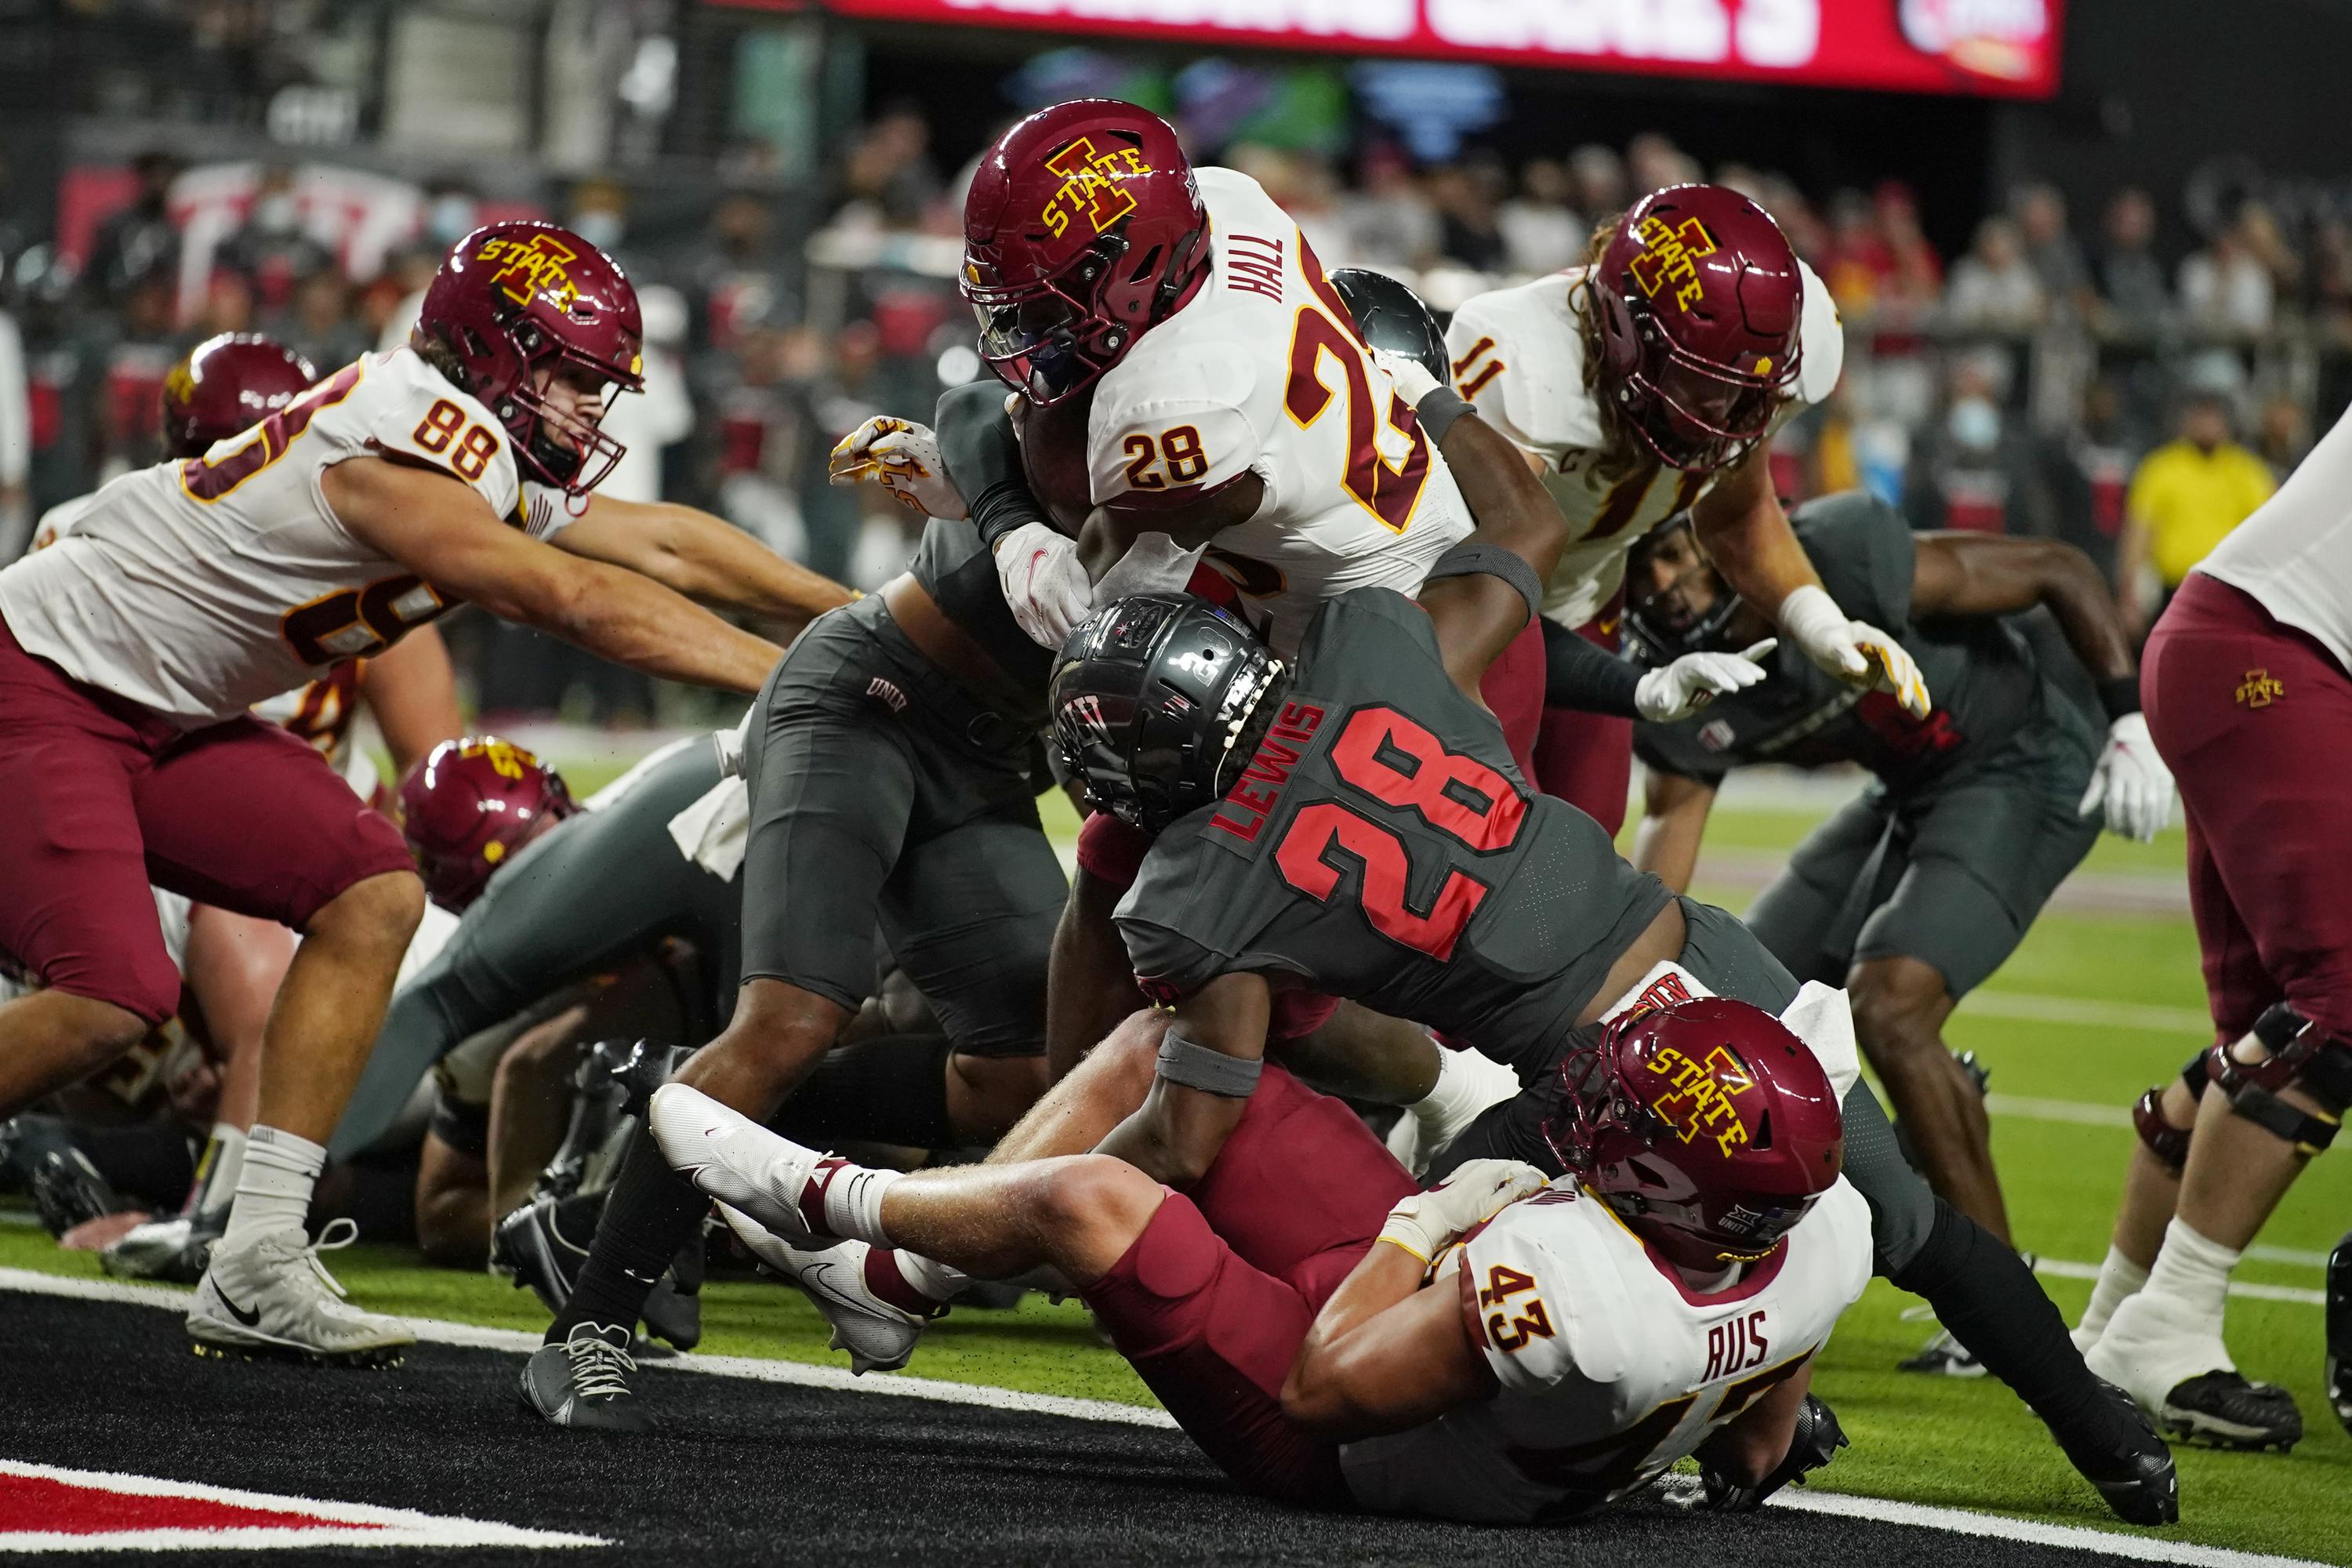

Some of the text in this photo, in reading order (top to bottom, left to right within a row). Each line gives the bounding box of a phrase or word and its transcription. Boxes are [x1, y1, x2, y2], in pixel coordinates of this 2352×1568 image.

[1042, 147, 1152, 238] STATE
[477, 241, 579, 314] STATE
[1228, 234, 1283, 303] HALL
[1632, 216, 1703, 312] STATE
[1453, 336, 1504, 401] 11
[412, 398, 499, 482] 88
[1123, 425, 1208, 491] 28
[866, 677, 909, 713] UNLV
[2235, 679, 2284, 703] STATE
[1209, 702, 1325, 844] LEWIS
[1274, 701, 1534, 963] 28
[1646, 1047, 1748, 1158] STATE
[1719, 1217, 1750, 1235] UNITY
[1479, 1264, 1556, 1353] 43
[1700, 1309, 1769, 1383] RUS
